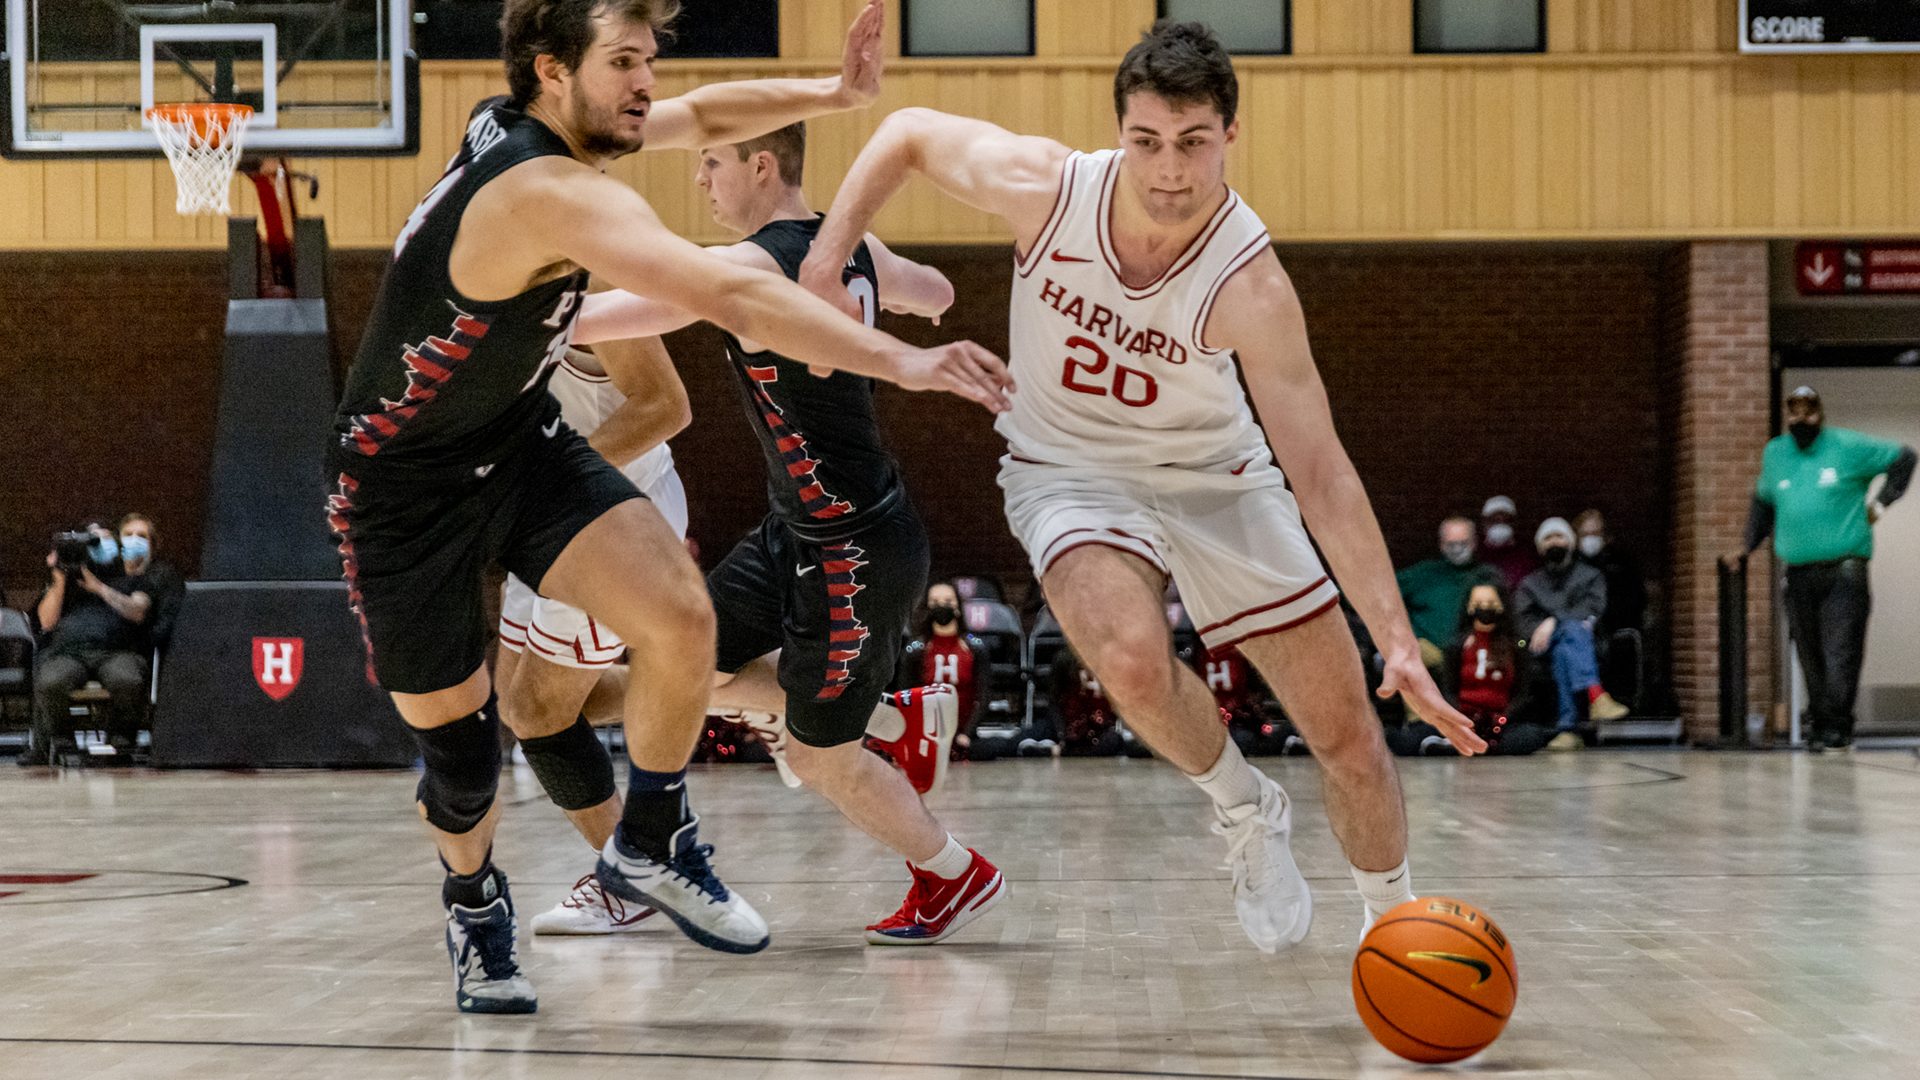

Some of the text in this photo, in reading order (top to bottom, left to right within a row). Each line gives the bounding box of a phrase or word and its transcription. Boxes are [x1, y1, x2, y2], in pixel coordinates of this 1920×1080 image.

[1752, 16, 1824, 42] SCORE
[1039, 277, 1187, 365] HARVARD
[1062, 335, 1158, 408] 20
[262, 643, 293, 684] H
[934, 654, 960, 685] H
[1205, 660, 1233, 691] H
[1427, 900, 1507, 952] ELITE
